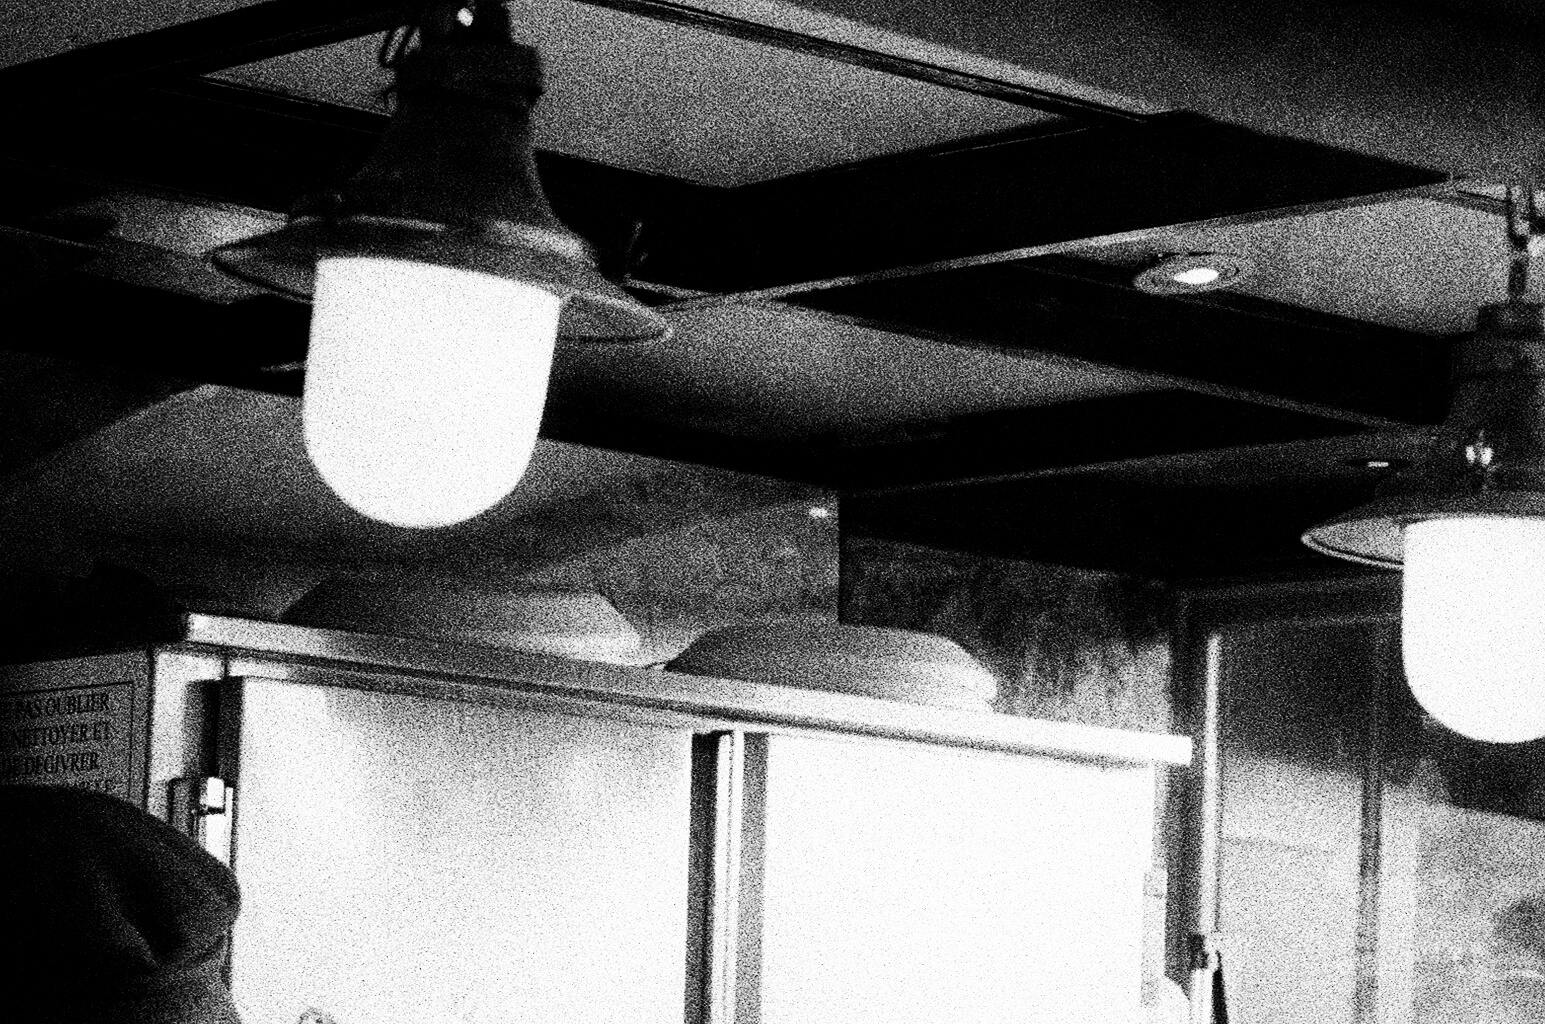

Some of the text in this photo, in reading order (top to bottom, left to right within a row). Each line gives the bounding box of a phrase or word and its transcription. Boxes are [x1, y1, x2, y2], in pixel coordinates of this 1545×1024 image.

[45, 692, 110, 718] OUBLIER
[12, 723, 88, 748] NETTOYER
[93, 721, 111, 742] ET
